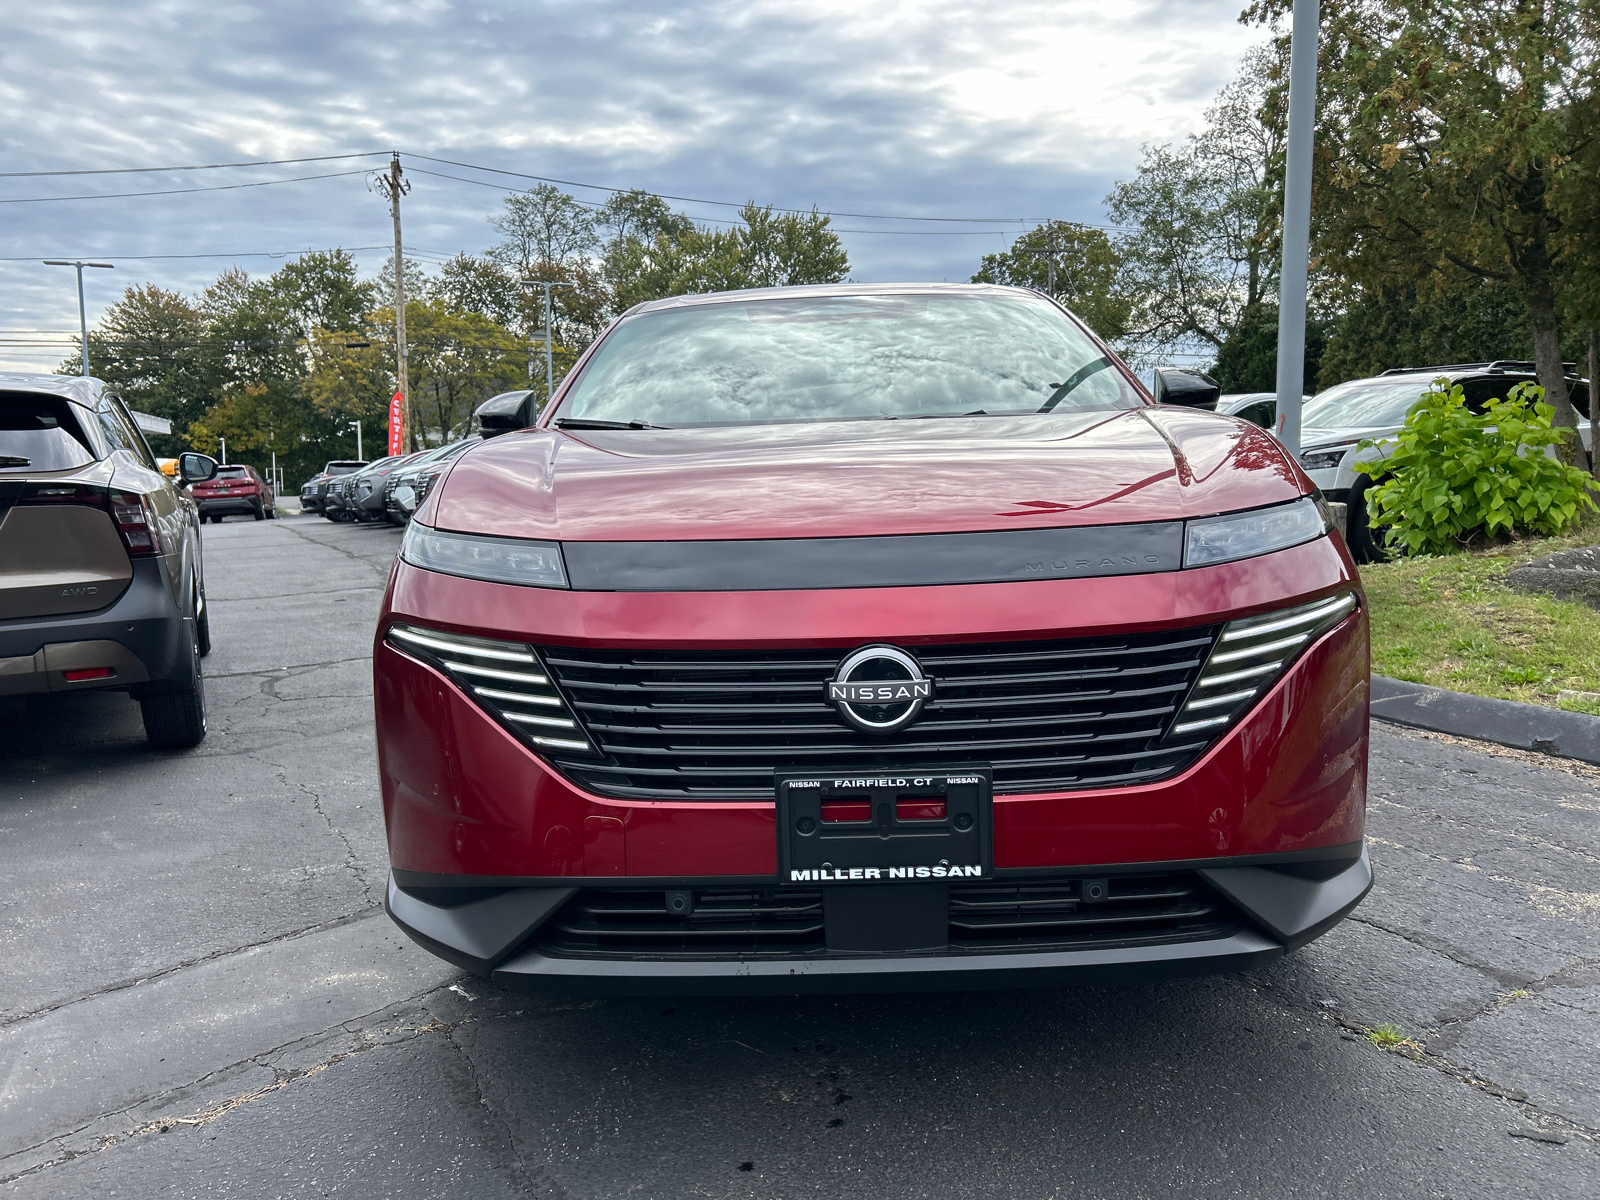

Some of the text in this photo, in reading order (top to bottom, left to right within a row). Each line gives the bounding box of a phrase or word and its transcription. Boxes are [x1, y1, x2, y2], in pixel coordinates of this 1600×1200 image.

[1026, 554, 1160, 572] MURANO
[60, 586, 97, 597] AWD
[831, 684, 928, 700] NISSAN
[834, 778, 933, 788] FAIRFIELD, CT
[791, 866, 981, 881] MILLER NISSAN
